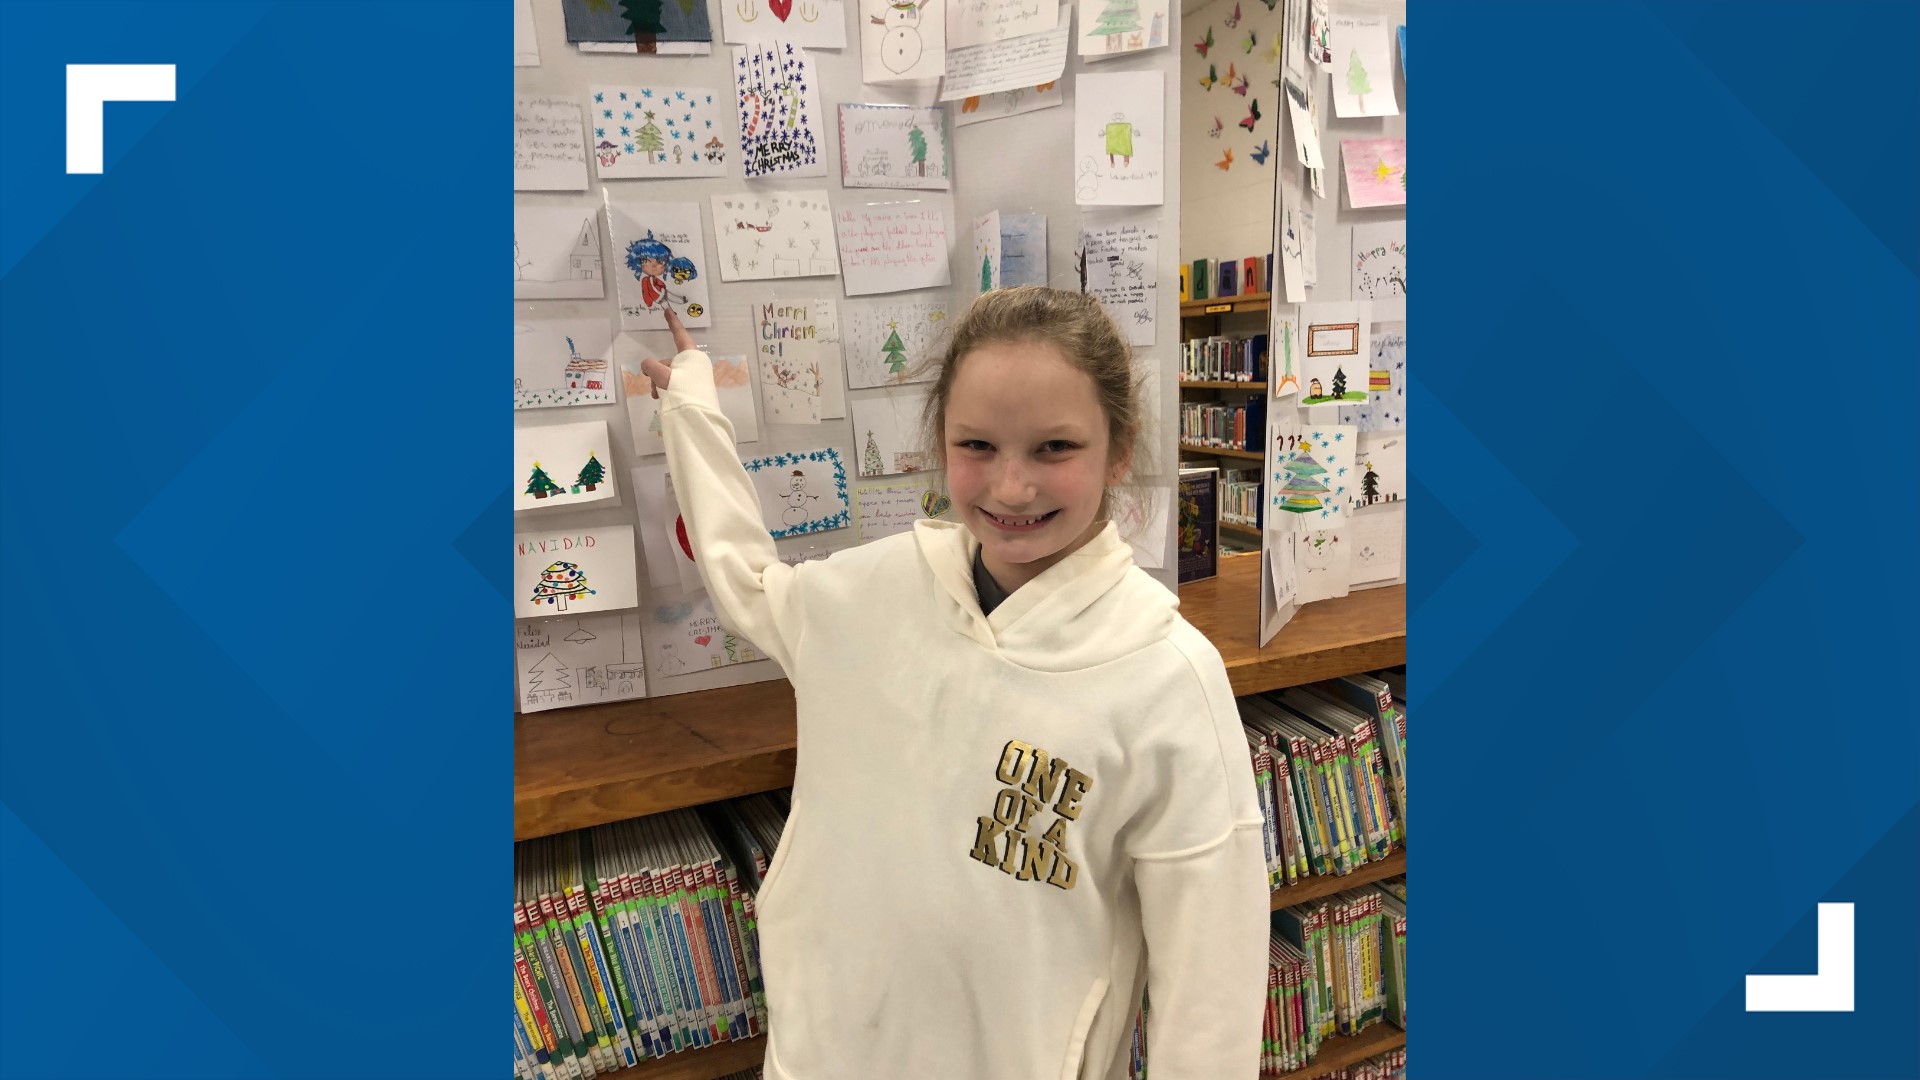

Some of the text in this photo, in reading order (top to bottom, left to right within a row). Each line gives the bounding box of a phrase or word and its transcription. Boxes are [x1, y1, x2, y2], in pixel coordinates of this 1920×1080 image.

[755, 140, 792, 160] MERRY
[752, 151, 799, 171] CHRISTMAS
[1358, 246, 1386, 262] Happy
[763, 302, 807, 320] Merri
[518, 536, 596, 556] NAVIDAD
[689, 617, 717, 628] MERRY
[996, 739, 1093, 821] ONE
[993, 788, 1067, 853] OF A
[970, 816, 1079, 890] KIND
[606, 940, 615, 953] The
[583, 944, 592, 957] The
[590, 971, 603, 993] Lesson
[608, 953, 618, 965] Big
[531, 960, 545, 980] PICNIC
[545, 999, 555, 1011] The
[548, 964, 561, 989] VACATION
[525, 987, 542, 1011] Christmas
